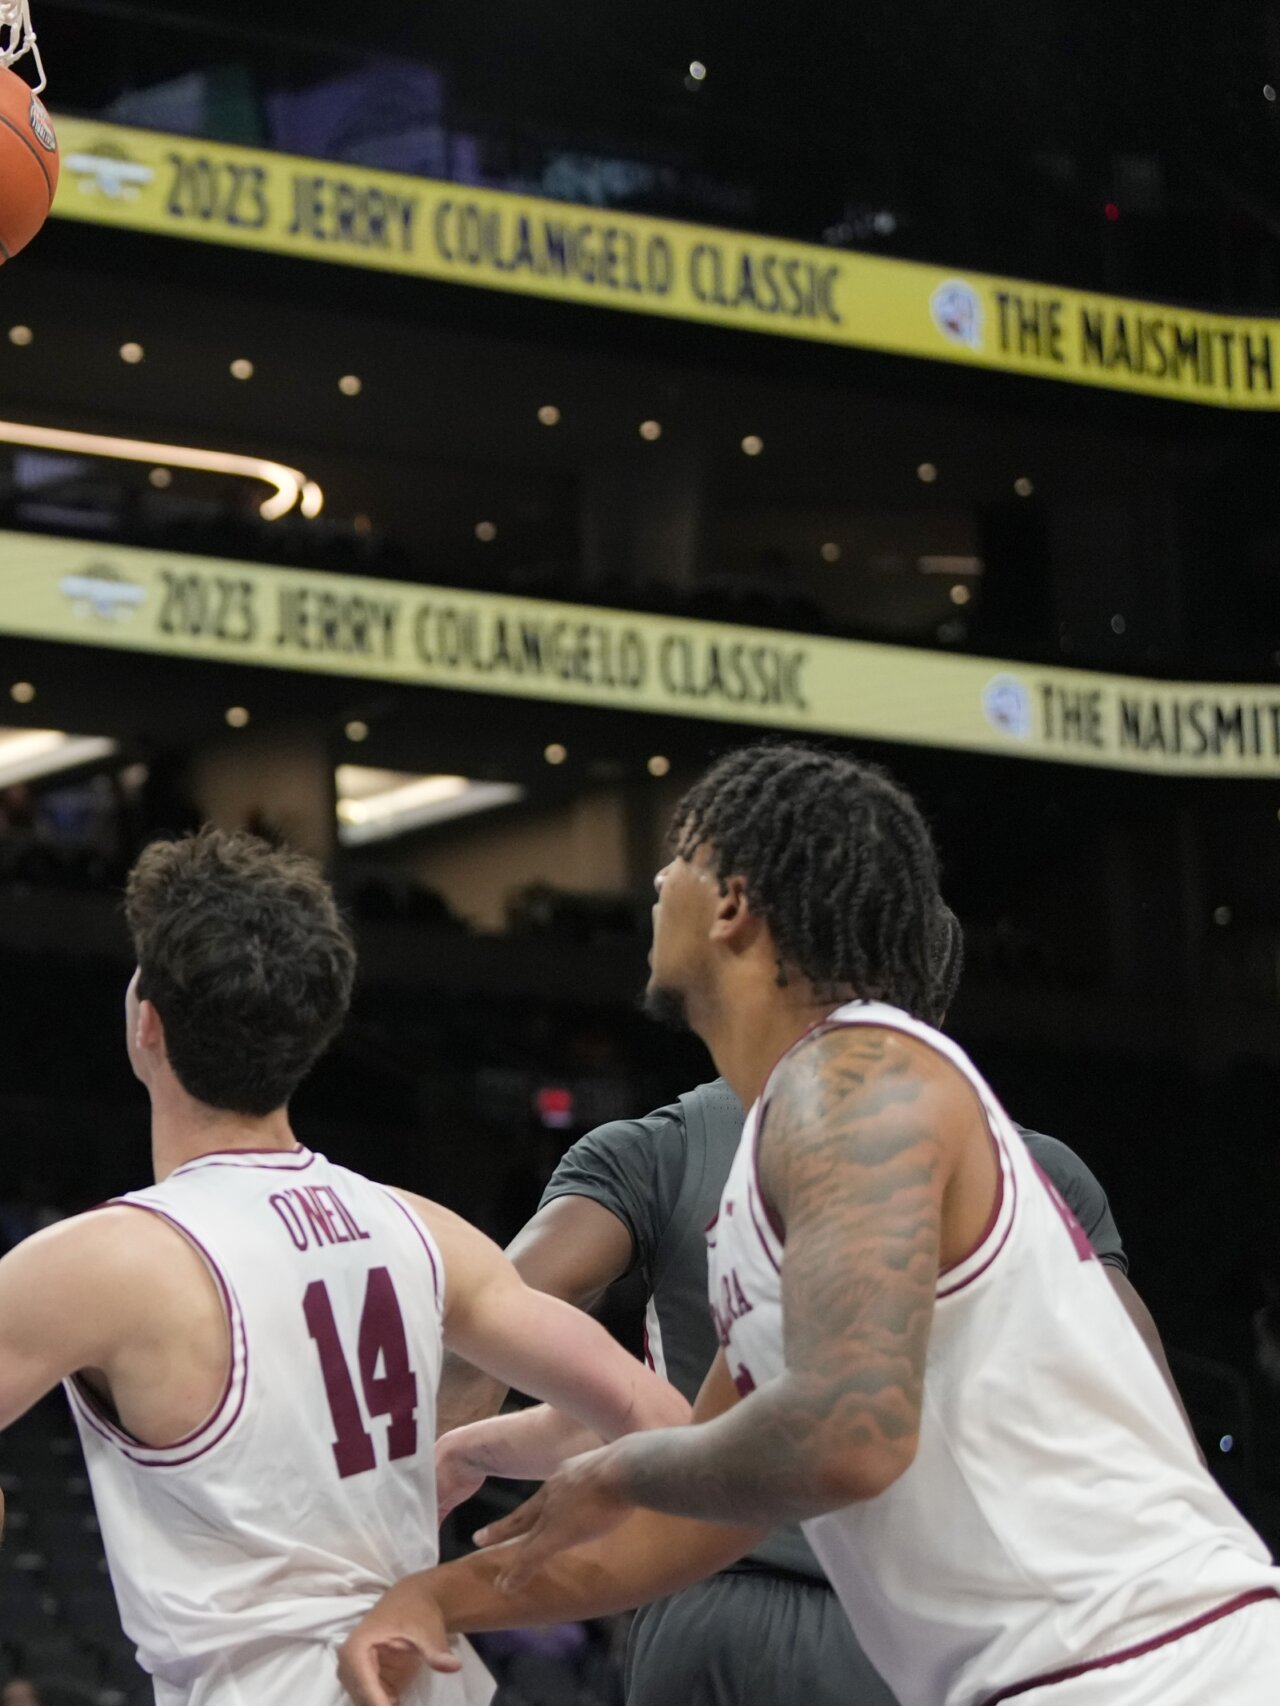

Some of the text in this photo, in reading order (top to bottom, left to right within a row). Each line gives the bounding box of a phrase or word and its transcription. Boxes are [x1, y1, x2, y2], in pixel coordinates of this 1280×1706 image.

[164, 150, 1274, 393] 2023 JERRY COLANGELO CLASSIC THE NAISMITH
[156, 567, 258, 643] 2023
[275, 584, 401, 660] JERRY
[414, 602, 649, 690] COLANGELO
[658, 634, 808, 711] CLASSIC
[1039, 680, 1107, 748] THE
[269, 1185, 371, 1251] O'NEIL
[302, 1266, 417, 1480] 14
